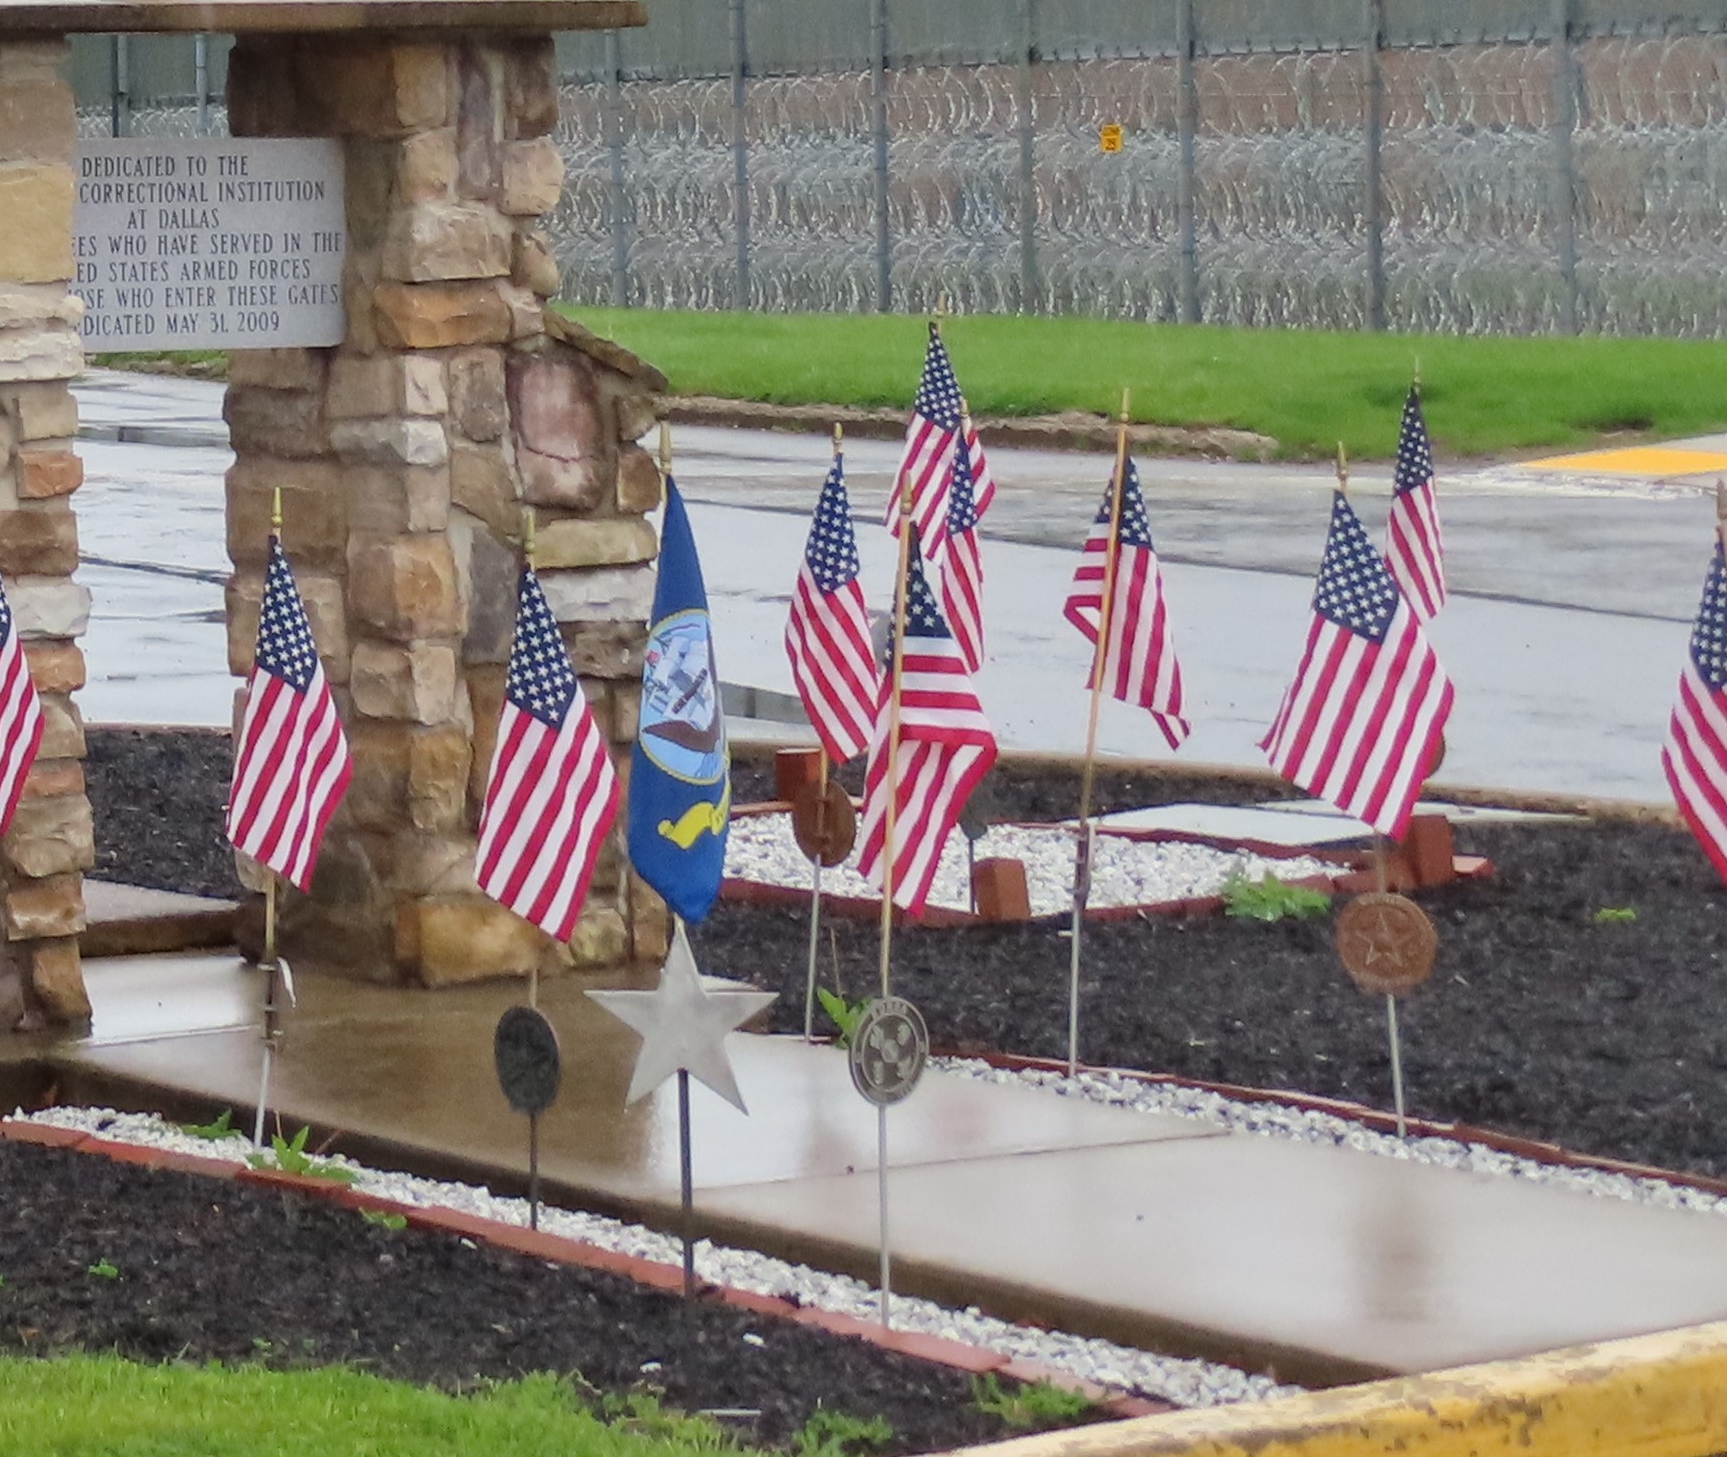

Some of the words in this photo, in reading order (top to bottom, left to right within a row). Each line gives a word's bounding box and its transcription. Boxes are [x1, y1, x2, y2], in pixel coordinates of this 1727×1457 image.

[82, 156, 175, 177] DEDICATED
[186, 156, 206, 176] TO
[218, 155, 248, 176] THE
[79, 181, 208, 203] CORRECTIONAL
[218, 181, 325, 202] INSTITUTION
[127, 208, 147, 229] AT
[159, 207, 220, 229] DALLAS
[108, 234, 146, 256] WHO
[158, 234, 197, 255] HAVE
[210, 233, 273, 255] SERVED
[283, 232, 301, 253] IN
[313, 232, 341, 253] THE
[109, 261, 169, 282] STATES
[180, 260, 238, 281] ARMED
[249, 259, 311, 280] FORCES
[115, 287, 154, 308] WHO
[165, 285, 217, 308] ENTER
[227, 285, 278, 306] THESE
[288, 284, 339, 305] GATES
[166, 313, 198, 334] MAY
[237, 311, 280, 332] 2009
